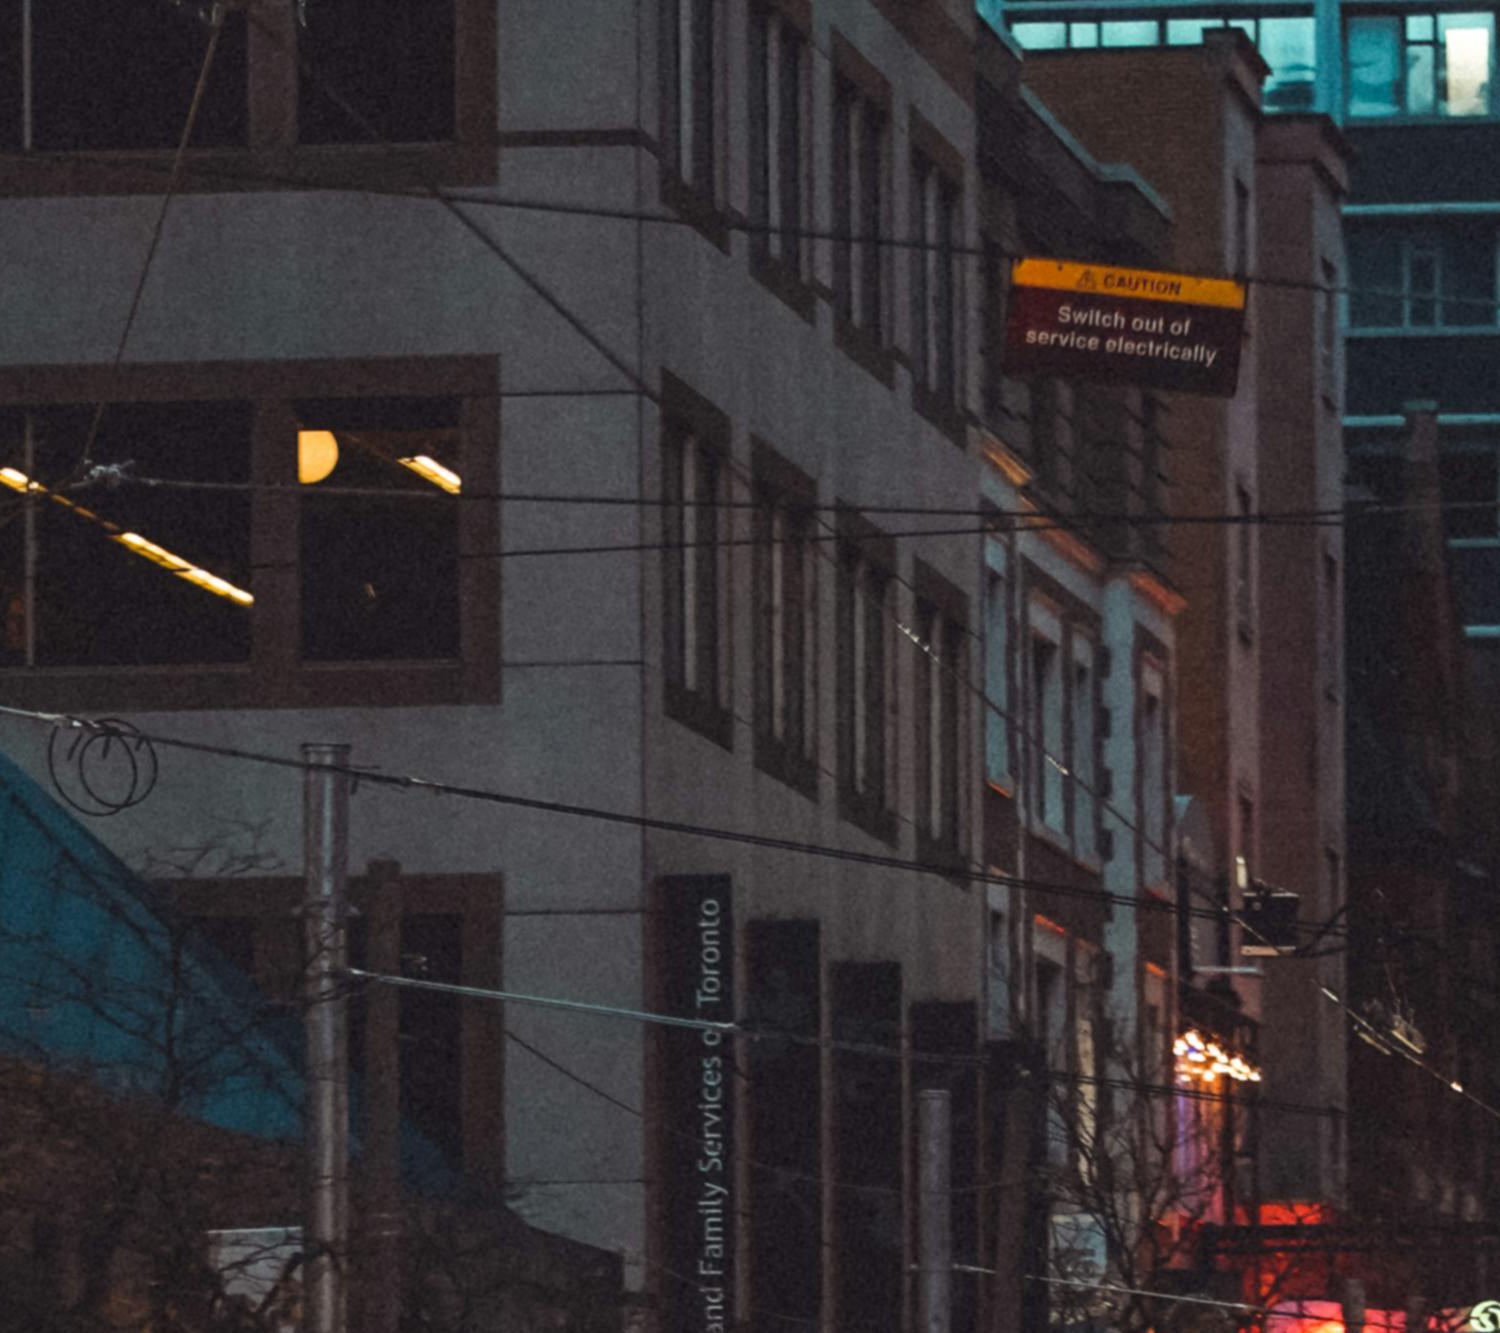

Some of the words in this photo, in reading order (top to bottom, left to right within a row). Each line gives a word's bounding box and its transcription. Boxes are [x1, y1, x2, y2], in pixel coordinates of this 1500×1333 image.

[1102, 273, 1183, 296] CAUTION
[1025, 330, 1099, 350] service
[1105, 336, 1217, 368] electrically
[1057, 305, 1126, 329] Switch
[1131, 315, 1164, 333] out
[1169, 317, 1191, 336] of
[696, 899, 721, 1007] Toronto
[698, 1057, 724, 1173] Services
[698, 1182, 729, 1275] Family
